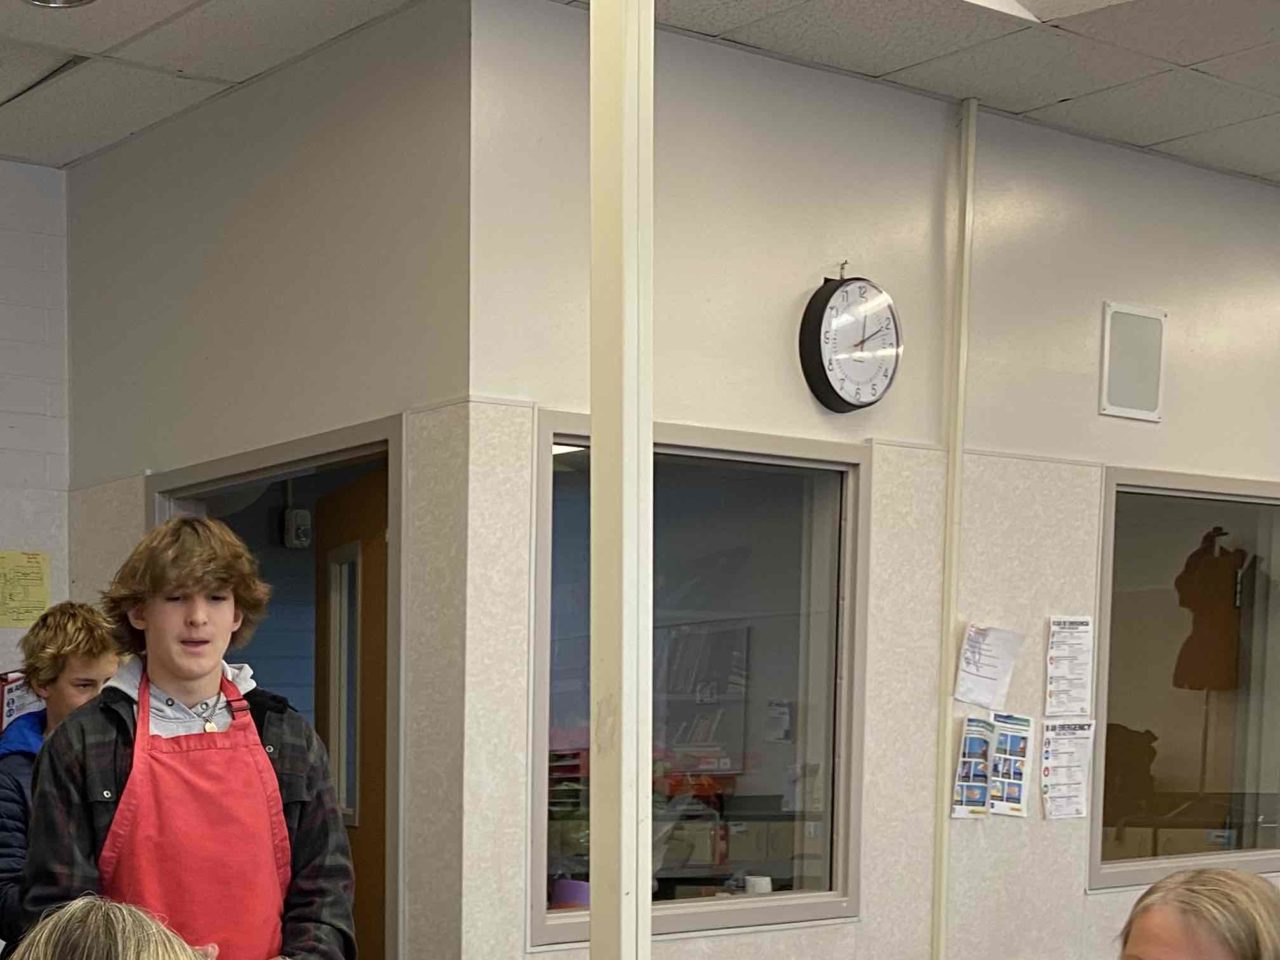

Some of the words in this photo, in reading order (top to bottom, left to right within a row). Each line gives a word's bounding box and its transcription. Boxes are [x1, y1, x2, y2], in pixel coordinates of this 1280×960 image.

[885, 317, 892, 330] 2
[854, 387, 861, 400] 6
[870, 384, 877, 397] 5
